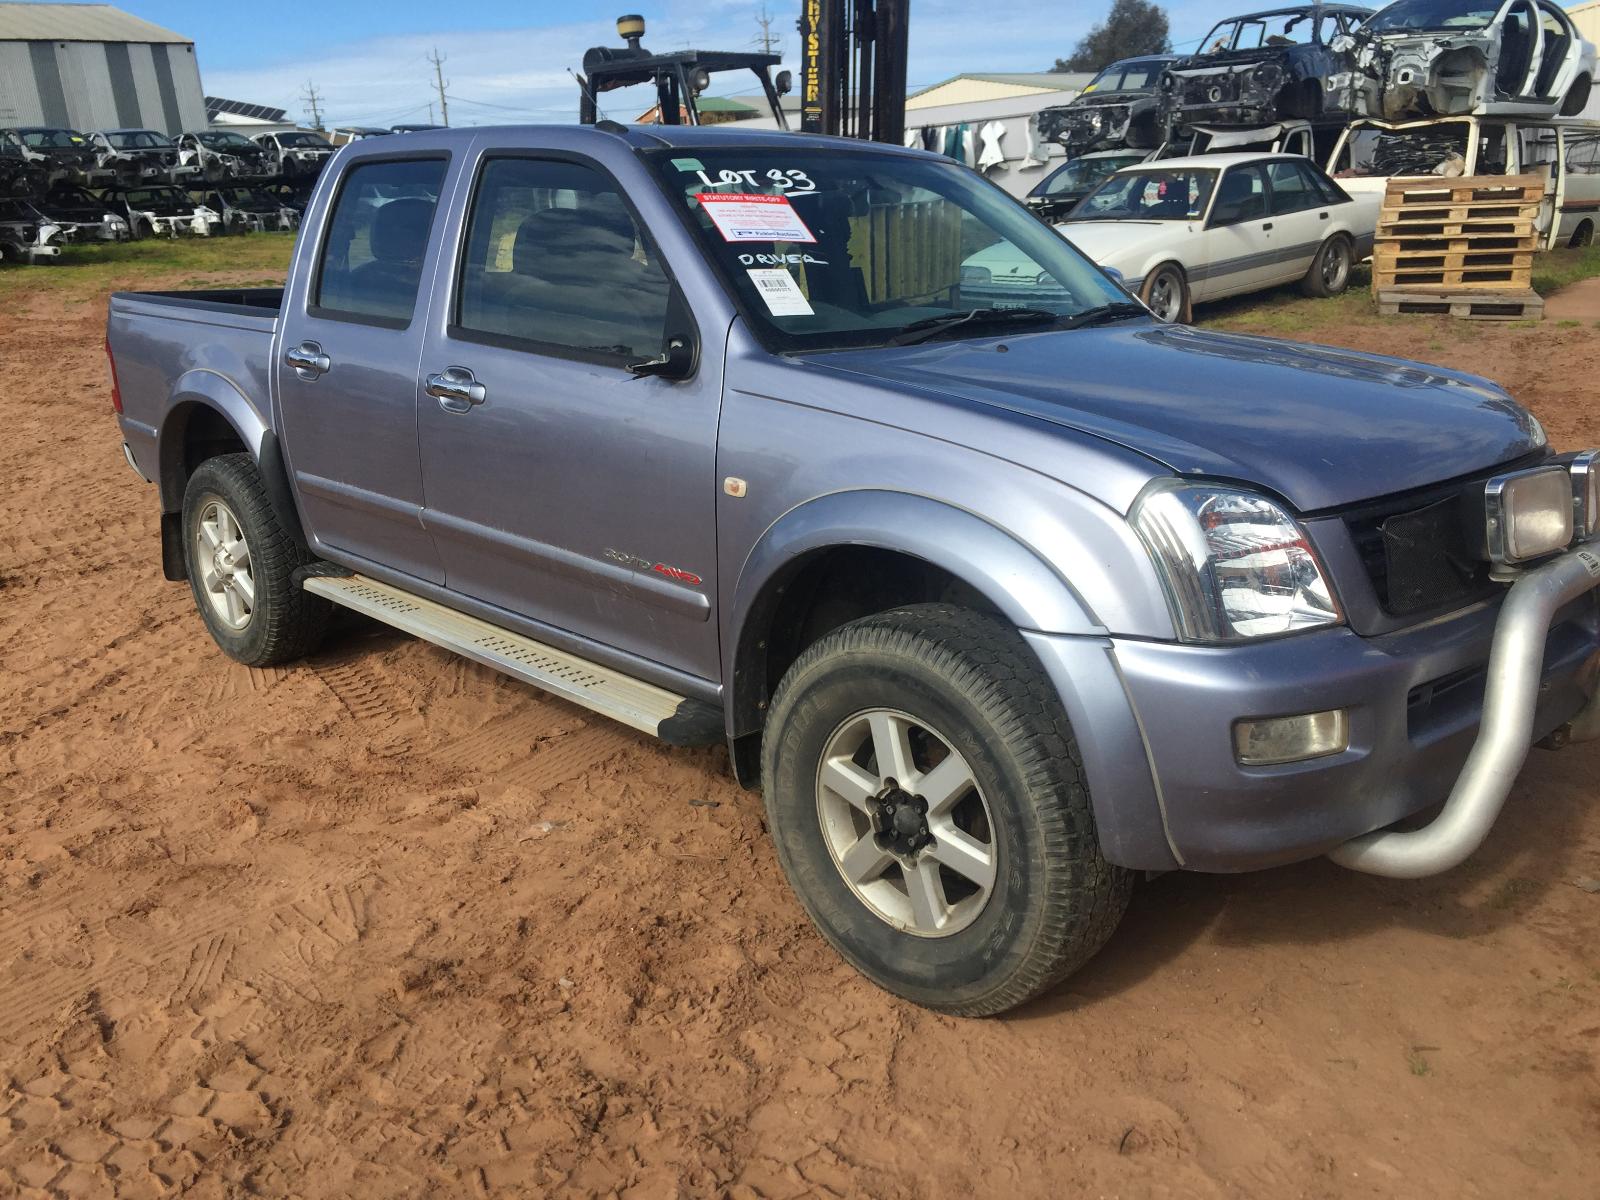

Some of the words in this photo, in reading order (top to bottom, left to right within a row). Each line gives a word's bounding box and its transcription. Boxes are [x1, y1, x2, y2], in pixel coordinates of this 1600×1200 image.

[806, 0, 820, 102] HYSTER
[696, 169, 760, 187] LOT
[766, 168, 816, 191] 33
[738, 253, 829, 265] DRIVER
